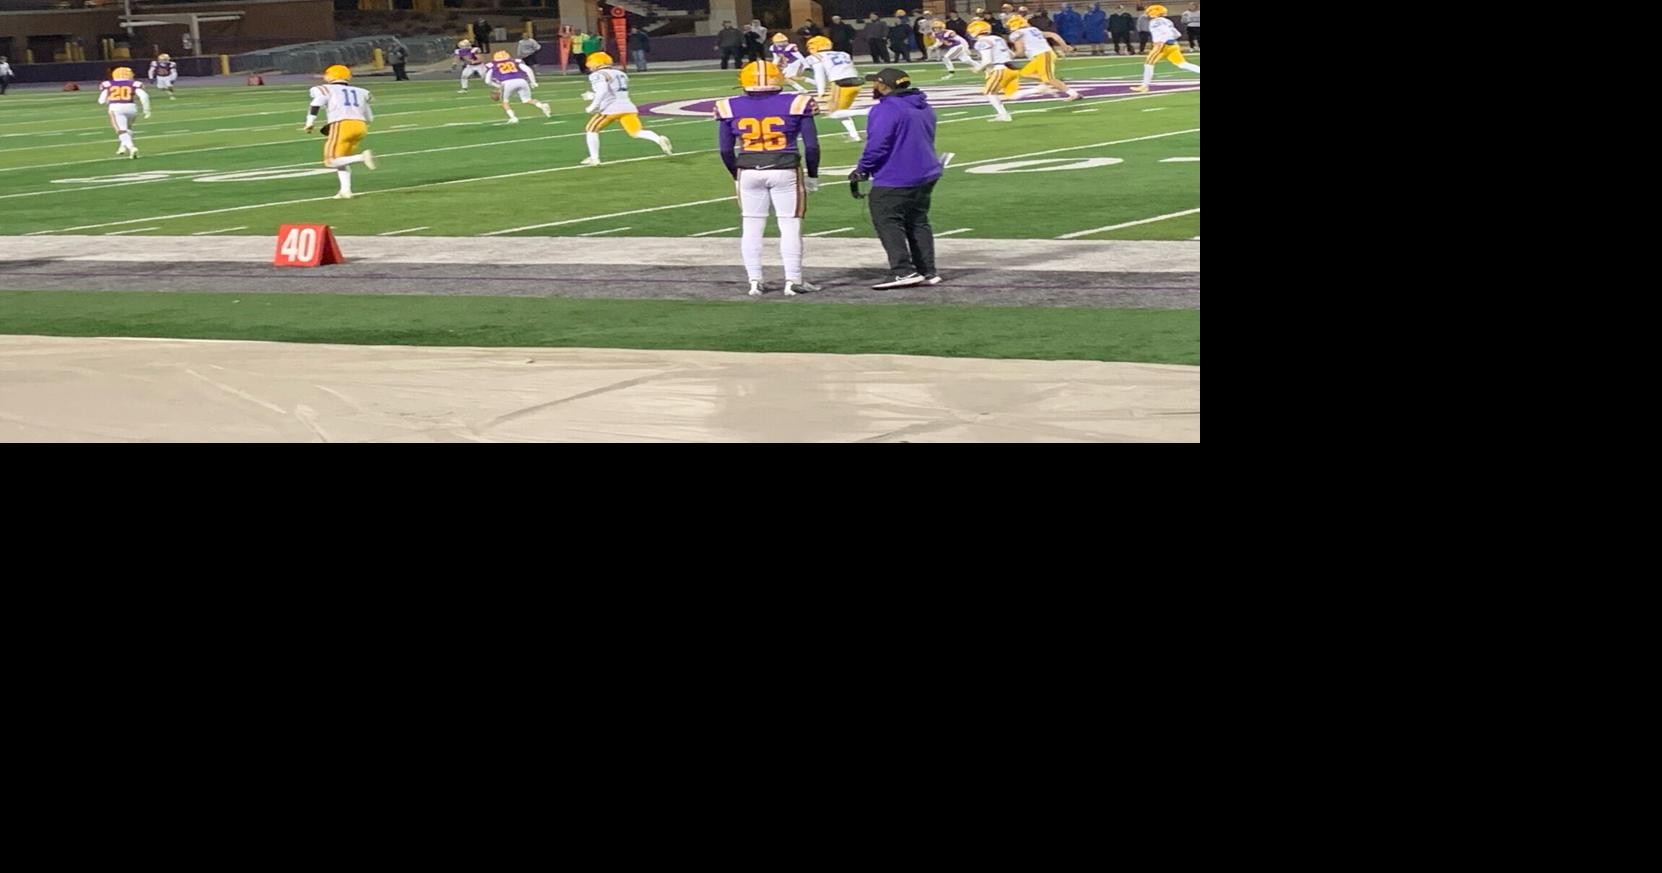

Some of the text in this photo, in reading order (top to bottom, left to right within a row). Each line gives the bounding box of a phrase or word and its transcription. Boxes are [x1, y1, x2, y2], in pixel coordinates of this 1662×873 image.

[107, 85, 132, 101] 20
[341, 88, 360, 107] 11
[738, 116, 787, 152] 26
[280, 227, 317, 263] 40
